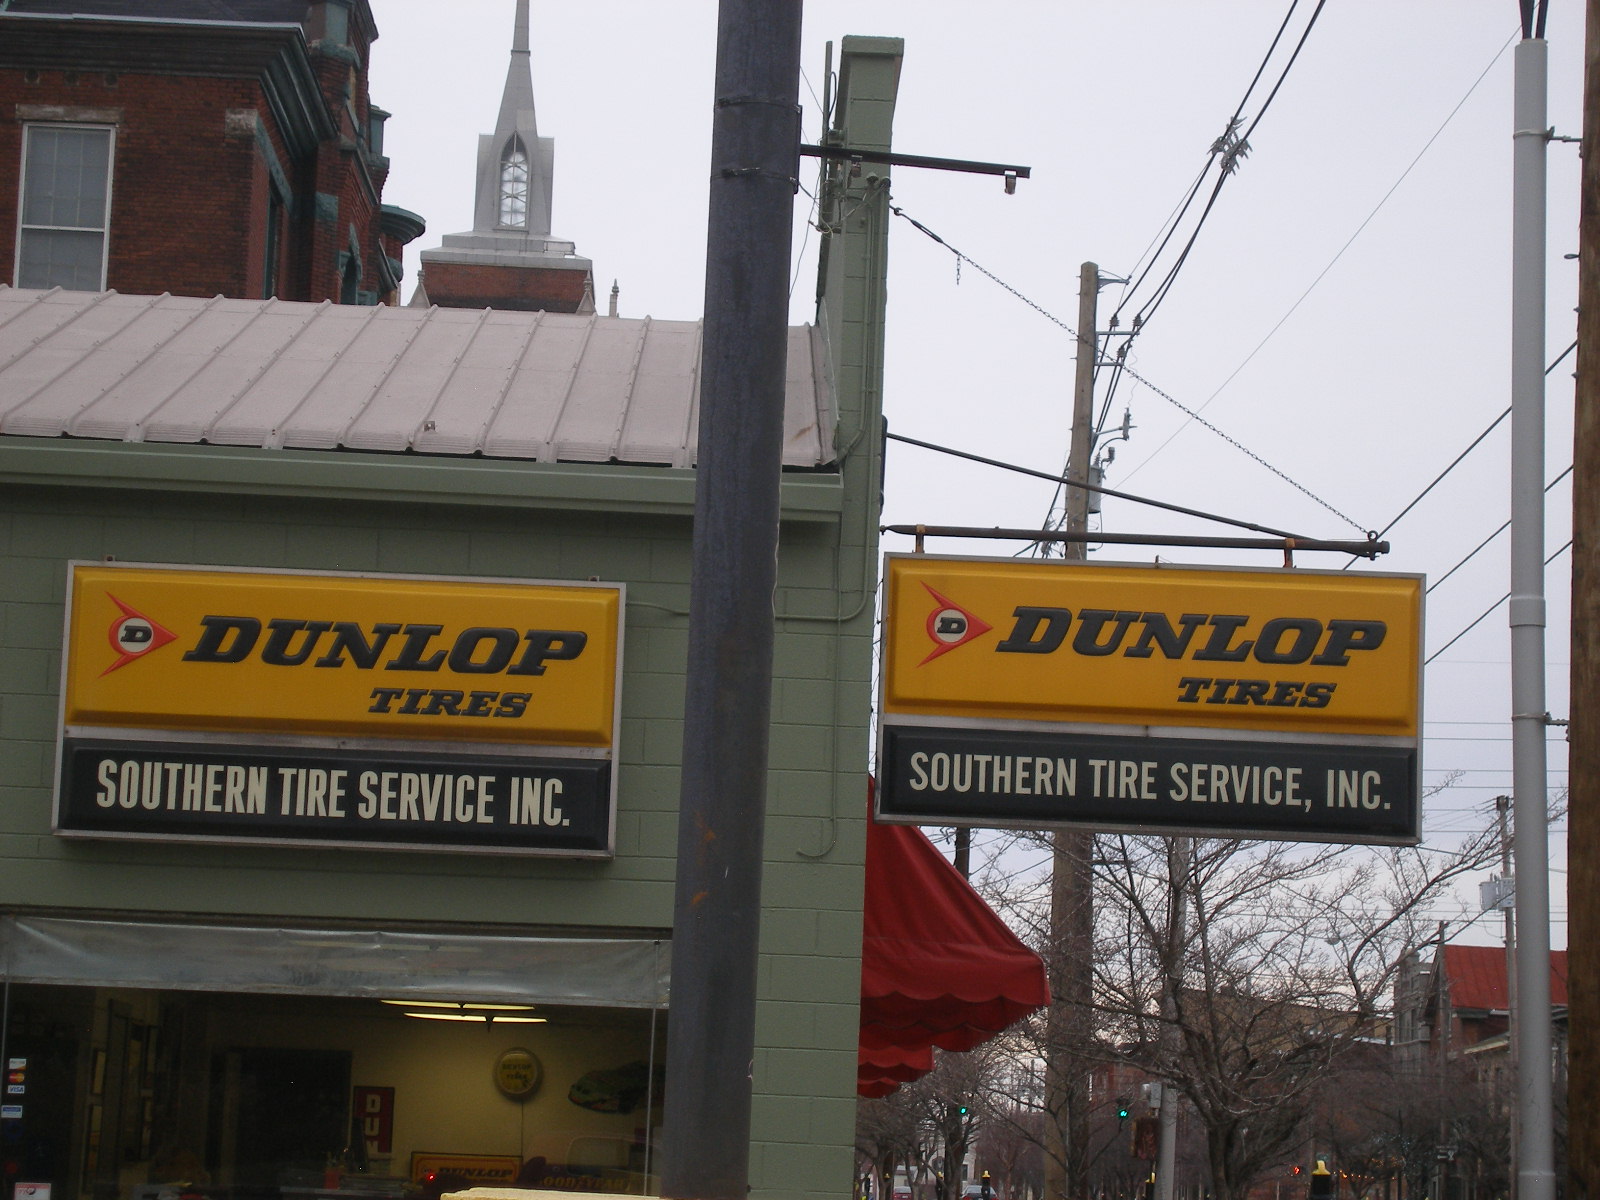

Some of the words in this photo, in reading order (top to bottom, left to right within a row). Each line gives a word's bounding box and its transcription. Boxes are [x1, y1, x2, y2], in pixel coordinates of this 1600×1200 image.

[118, 623, 154, 643] D
[182, 615, 588, 677] DUNLOP
[936, 616, 968, 634] D
[995, 605, 1388, 667] DUNLOP
[368, 687, 533, 718] TIRES
[1177, 676, 1337, 709] TIRES
[96, 759, 267, 815] SOUTHERN
[279, 768, 348, 818] TIRE
[358, 770, 497, 825] SERVICE
[509, 776, 571, 828] INC.
[909, 751, 1077, 797] SOUTHERN
[1088, 758, 1158, 801] TIRE
[1169, 762, 1313, 813] SERVICE,
[1326, 769, 1391, 811] INC.
